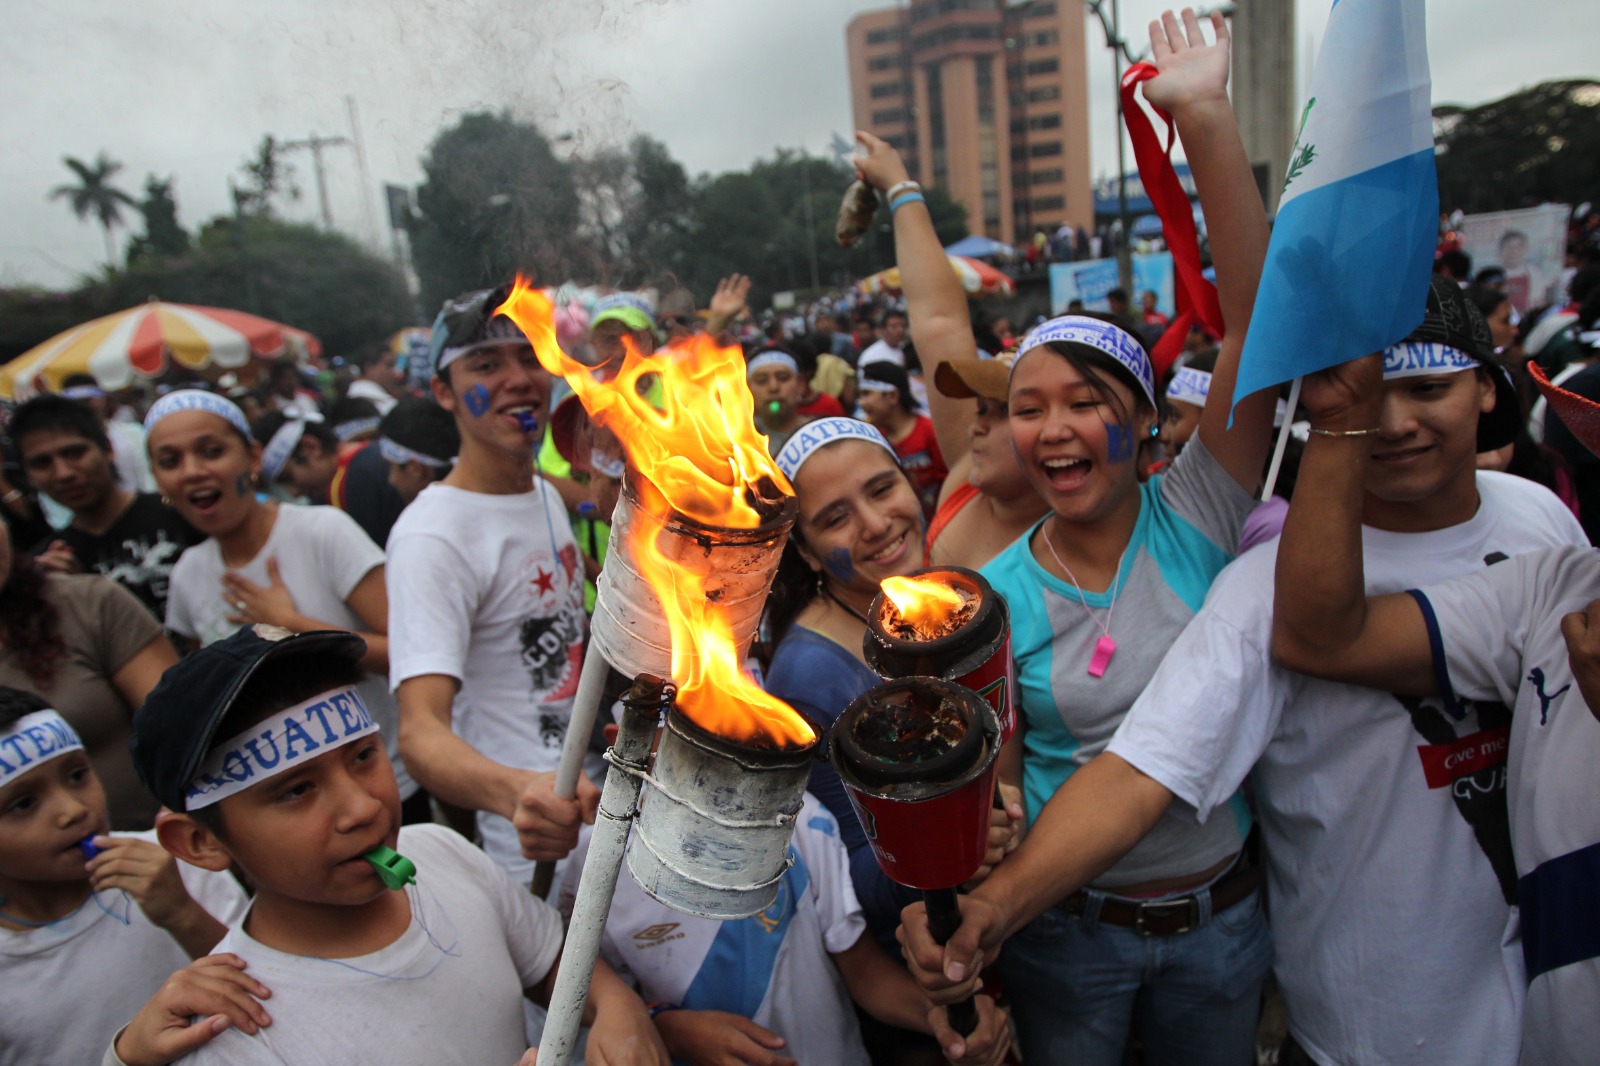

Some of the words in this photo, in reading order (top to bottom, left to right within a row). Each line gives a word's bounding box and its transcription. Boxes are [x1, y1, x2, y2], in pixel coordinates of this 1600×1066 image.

[1029, 331, 1076, 350] PURO
[1083, 334, 1141, 377] CHAPIN
[1481, 737, 1506, 756] me
